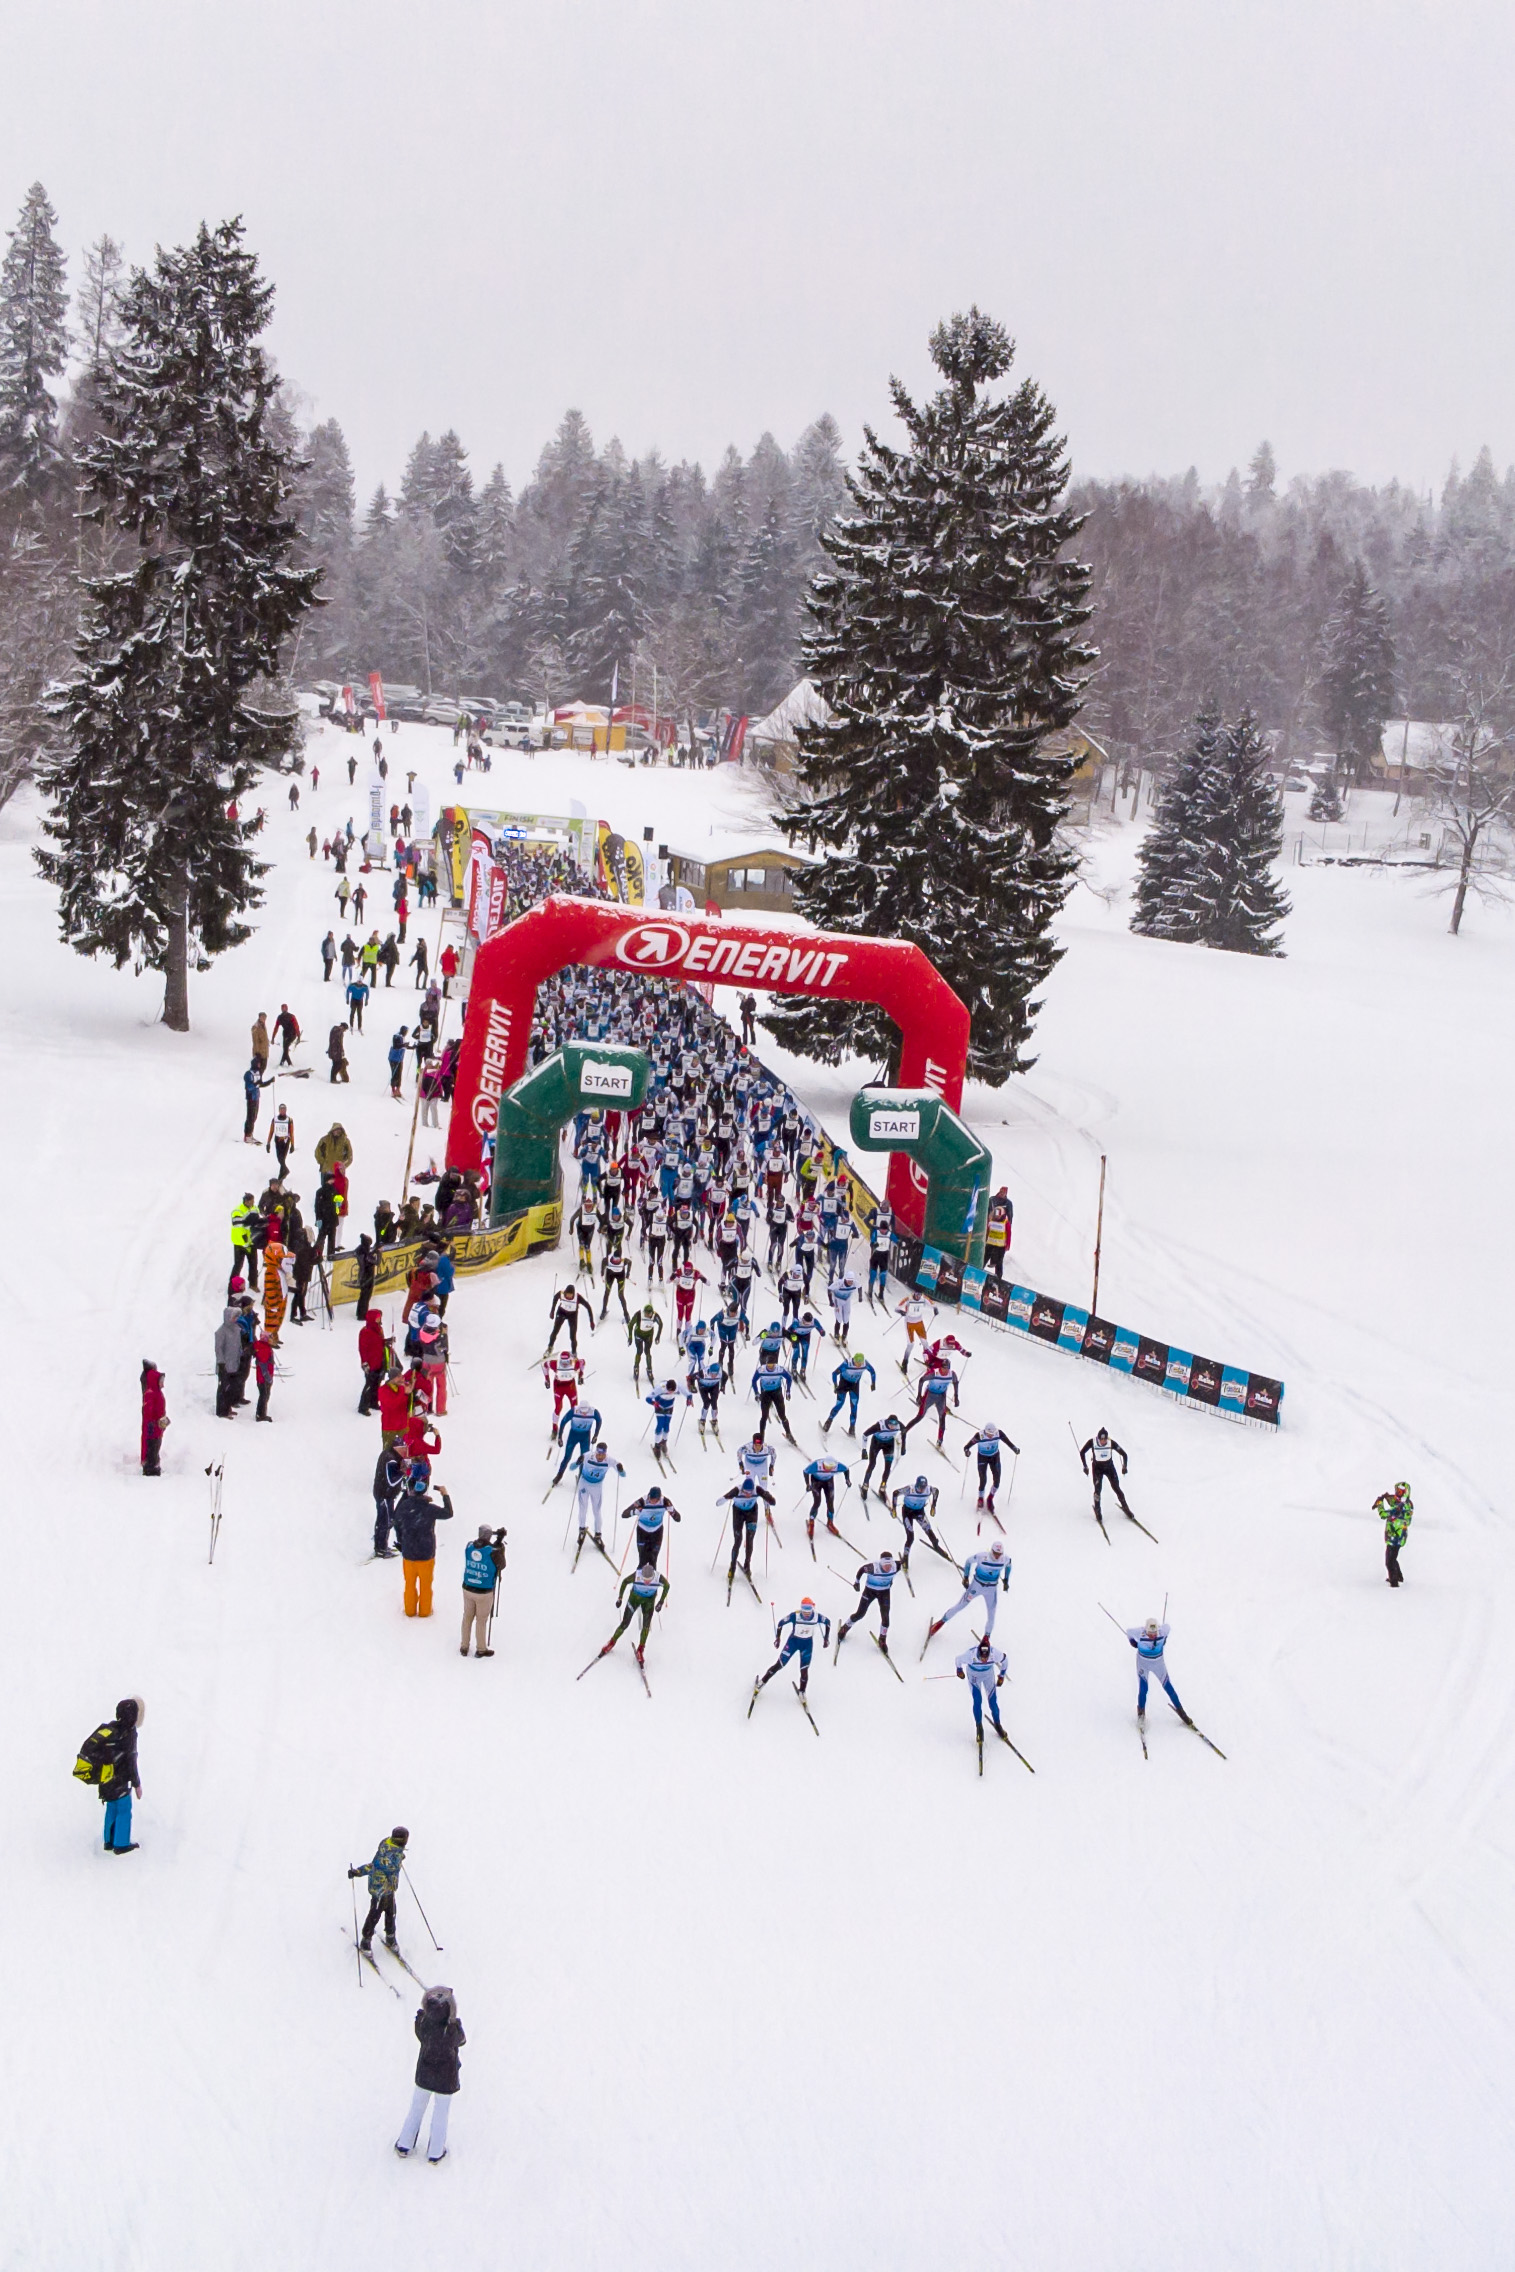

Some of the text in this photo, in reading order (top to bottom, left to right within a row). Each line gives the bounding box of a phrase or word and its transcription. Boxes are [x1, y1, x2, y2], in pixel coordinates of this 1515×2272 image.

[683, 935, 849, 987] ENERVIT
[479, 998, 513, 1102] ENERVIT
[584, 1075, 630, 1090] START
[873, 1121, 917, 1133] START
[350, 1251, 417, 1281] swax
[466, 1560, 488, 1571] FOTO
